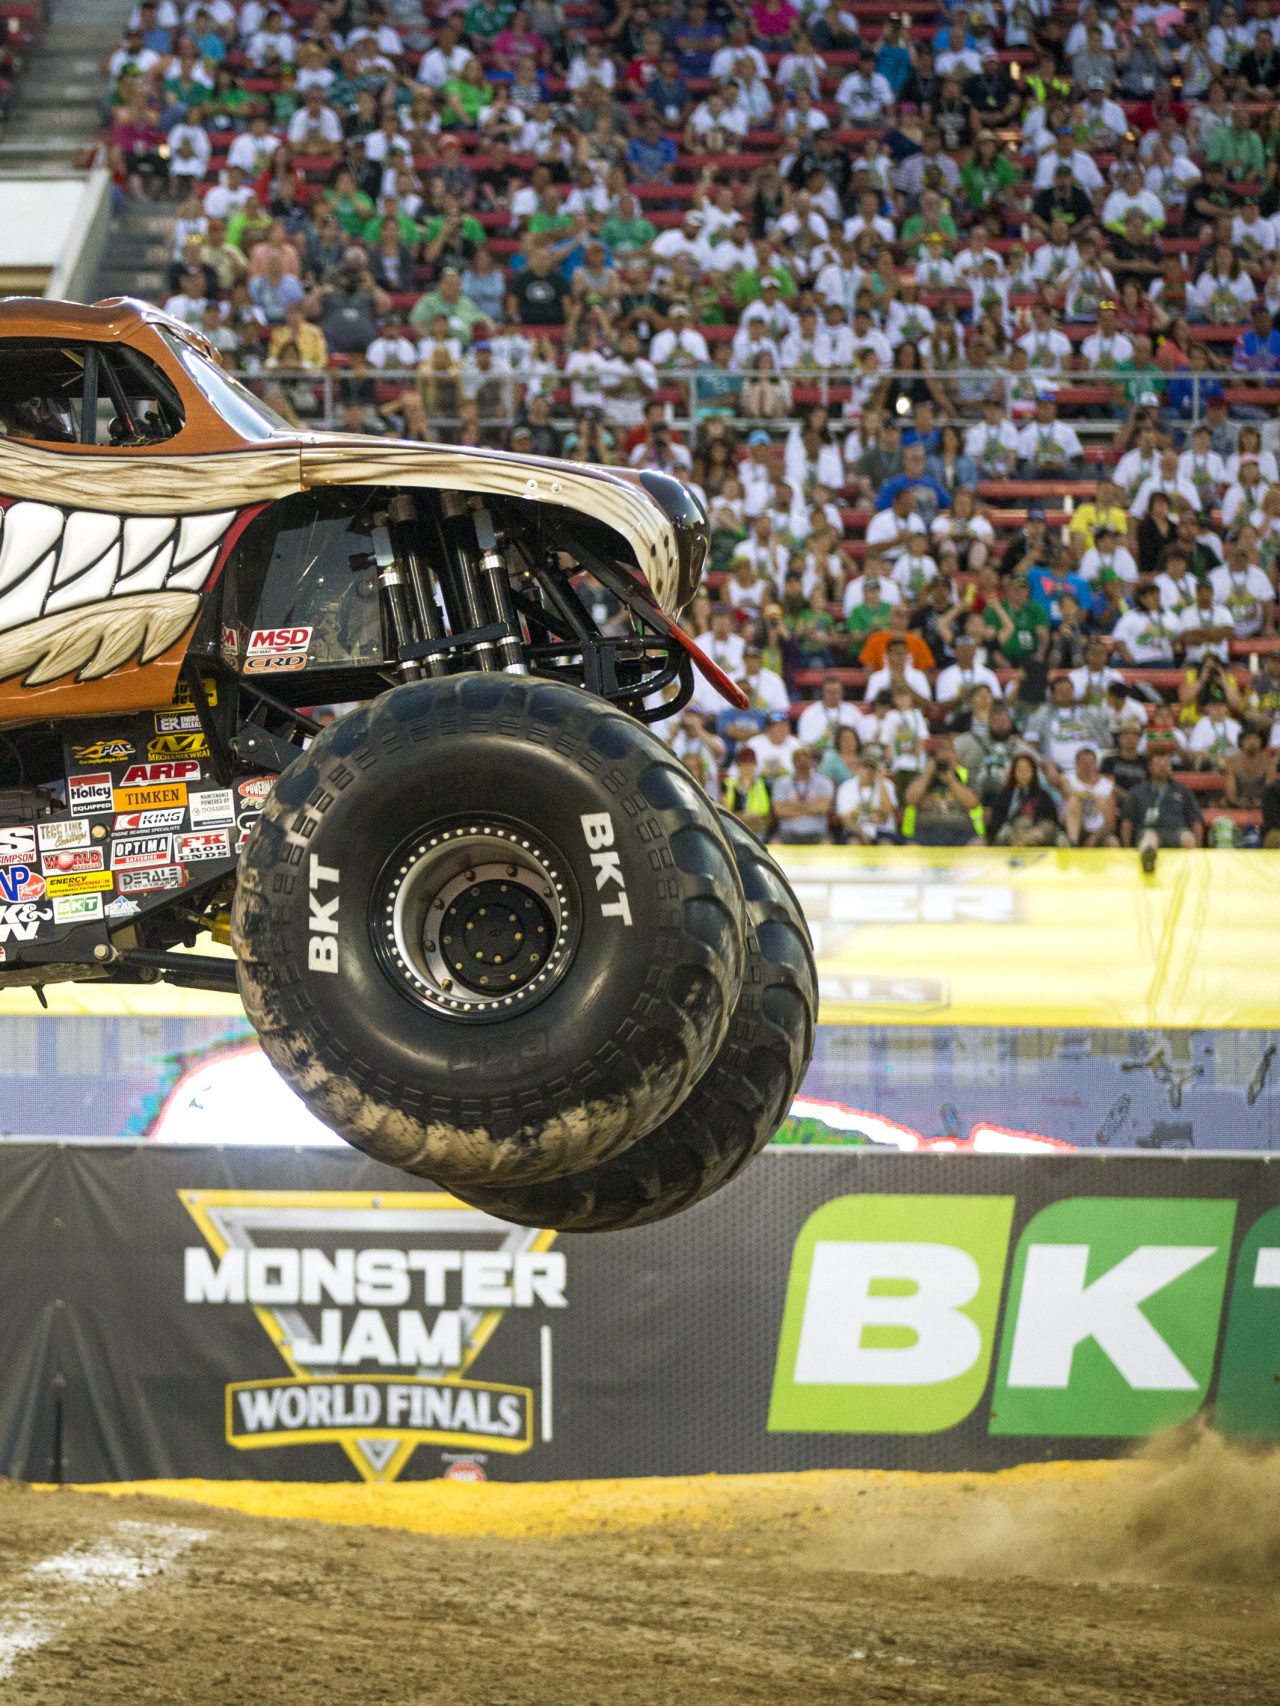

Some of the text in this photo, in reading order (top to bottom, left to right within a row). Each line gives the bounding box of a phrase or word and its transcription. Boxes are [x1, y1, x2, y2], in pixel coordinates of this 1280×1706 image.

[252, 628, 309, 648] MSD
[248, 656, 305, 668] CRD
[100, 744, 136, 756] PAC
[148, 753, 189, 762] MECHANIX
[123, 761, 199, 782] ARP
[71, 786, 111, 799] Holley
[125, 789, 180, 805] TIMKEN
[73, 802, 112, 812] EQUIPPED
[142, 811, 181, 825] KING
[64, 822, 83, 834] LINE
[116, 838, 167, 857] OPTIMA
[181, 834, 226, 848] FK
[179, 851, 228, 861] ENDS
[189, 845, 227, 853] ROD
[123, 868, 178, 885] DERALE
[580, 812, 632, 926] BKT
[50, 876, 87, 885] ENERGY
[58, 896, 98, 915] BKT
[308, 853, 340, 974] BKT
[184, 1247, 568, 1308] MONSTER
[292, 1309, 462, 1366] JAM
[238, 1383, 521, 1436] WORLD FINALS
